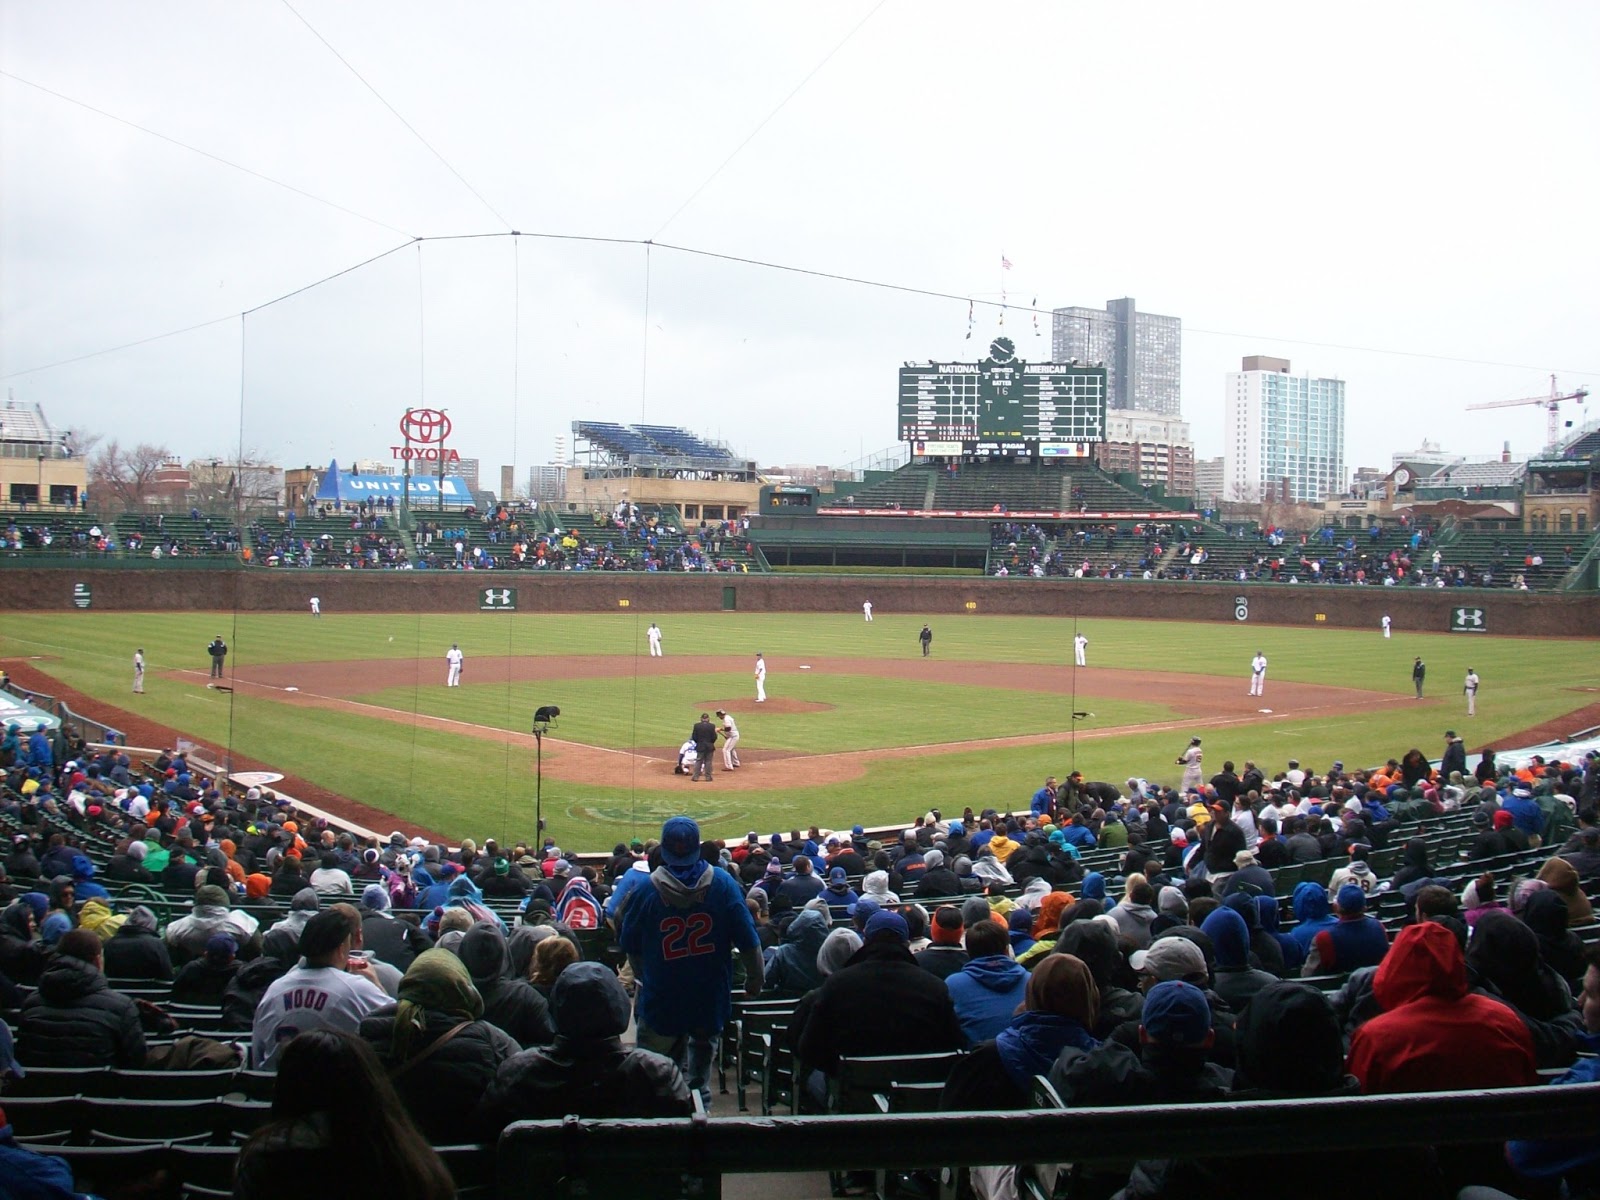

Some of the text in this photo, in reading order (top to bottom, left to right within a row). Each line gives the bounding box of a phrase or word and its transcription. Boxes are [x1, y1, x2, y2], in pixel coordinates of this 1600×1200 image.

[939, 365, 980, 373] NATIONAL
[1024, 365, 1066, 373] AMERICAN
[997, 387, 1008, 395] 16
[390, 447, 460, 462] TOYOTA
[350, 480, 431, 492] UNITED
[660, 913, 715, 960] 22
[283, 989, 328, 1012] WOOD
